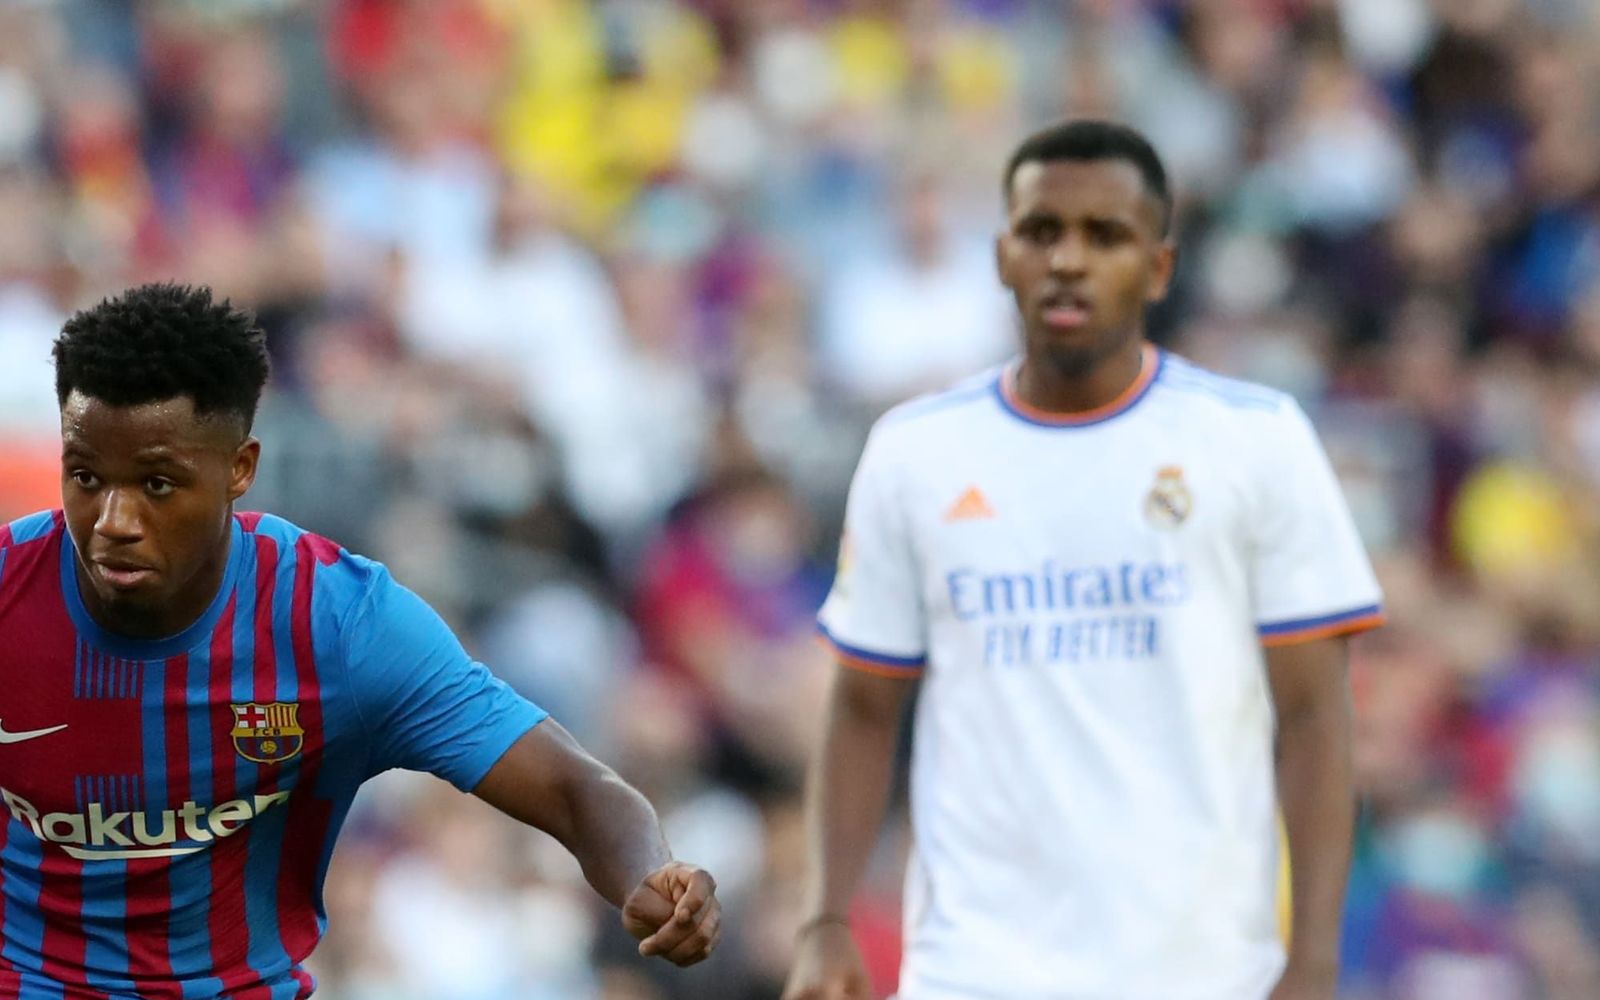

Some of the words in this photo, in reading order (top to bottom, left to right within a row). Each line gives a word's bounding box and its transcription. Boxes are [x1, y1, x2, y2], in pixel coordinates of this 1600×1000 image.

[946, 558, 1190, 621] Emirates
[983, 622, 1031, 667] FLY
[1049, 613, 1157, 663] BETTER
